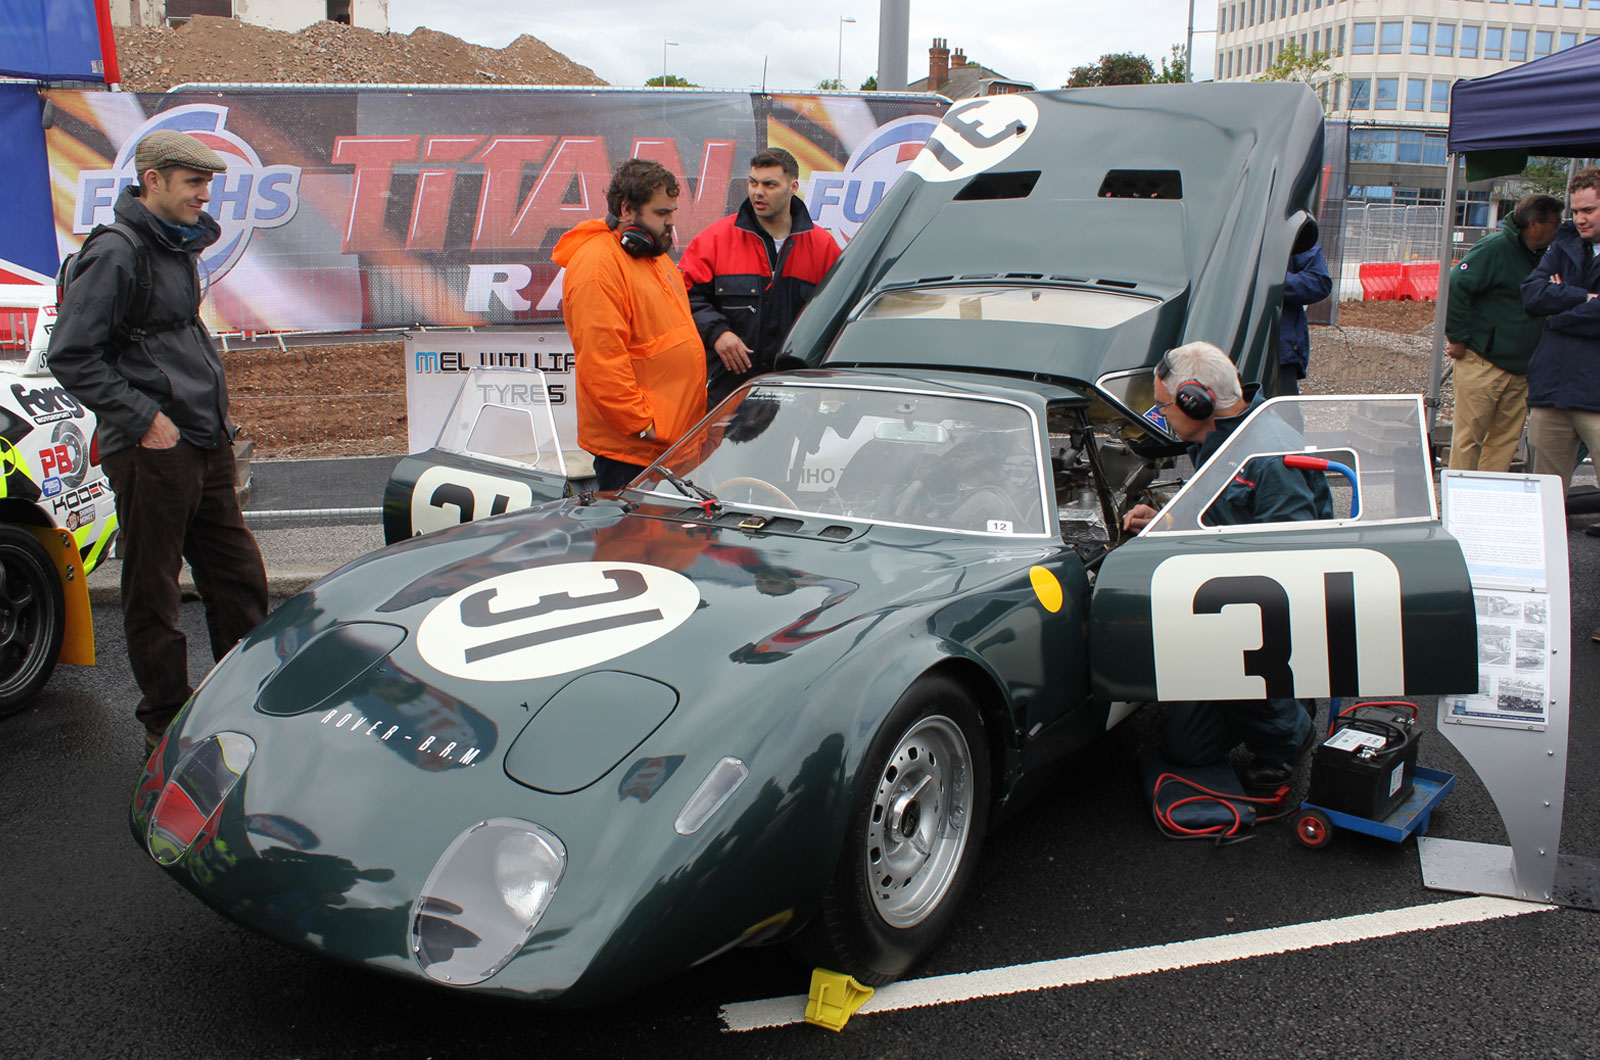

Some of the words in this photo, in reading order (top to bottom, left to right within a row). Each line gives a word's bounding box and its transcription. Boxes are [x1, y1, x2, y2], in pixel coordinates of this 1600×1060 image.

[81, 172, 293, 226] FHS
[810, 177, 886, 223] FU
[416, 352, 470, 373] MEL
[476, 384, 566, 405] TYRES
[39, 444, 73, 478] PB
[993, 522, 1007, 531] 12
[460, 569, 664, 664] 31
[1193, 571, 1360, 699] 31
[321, 709, 399, 741] ROVER
